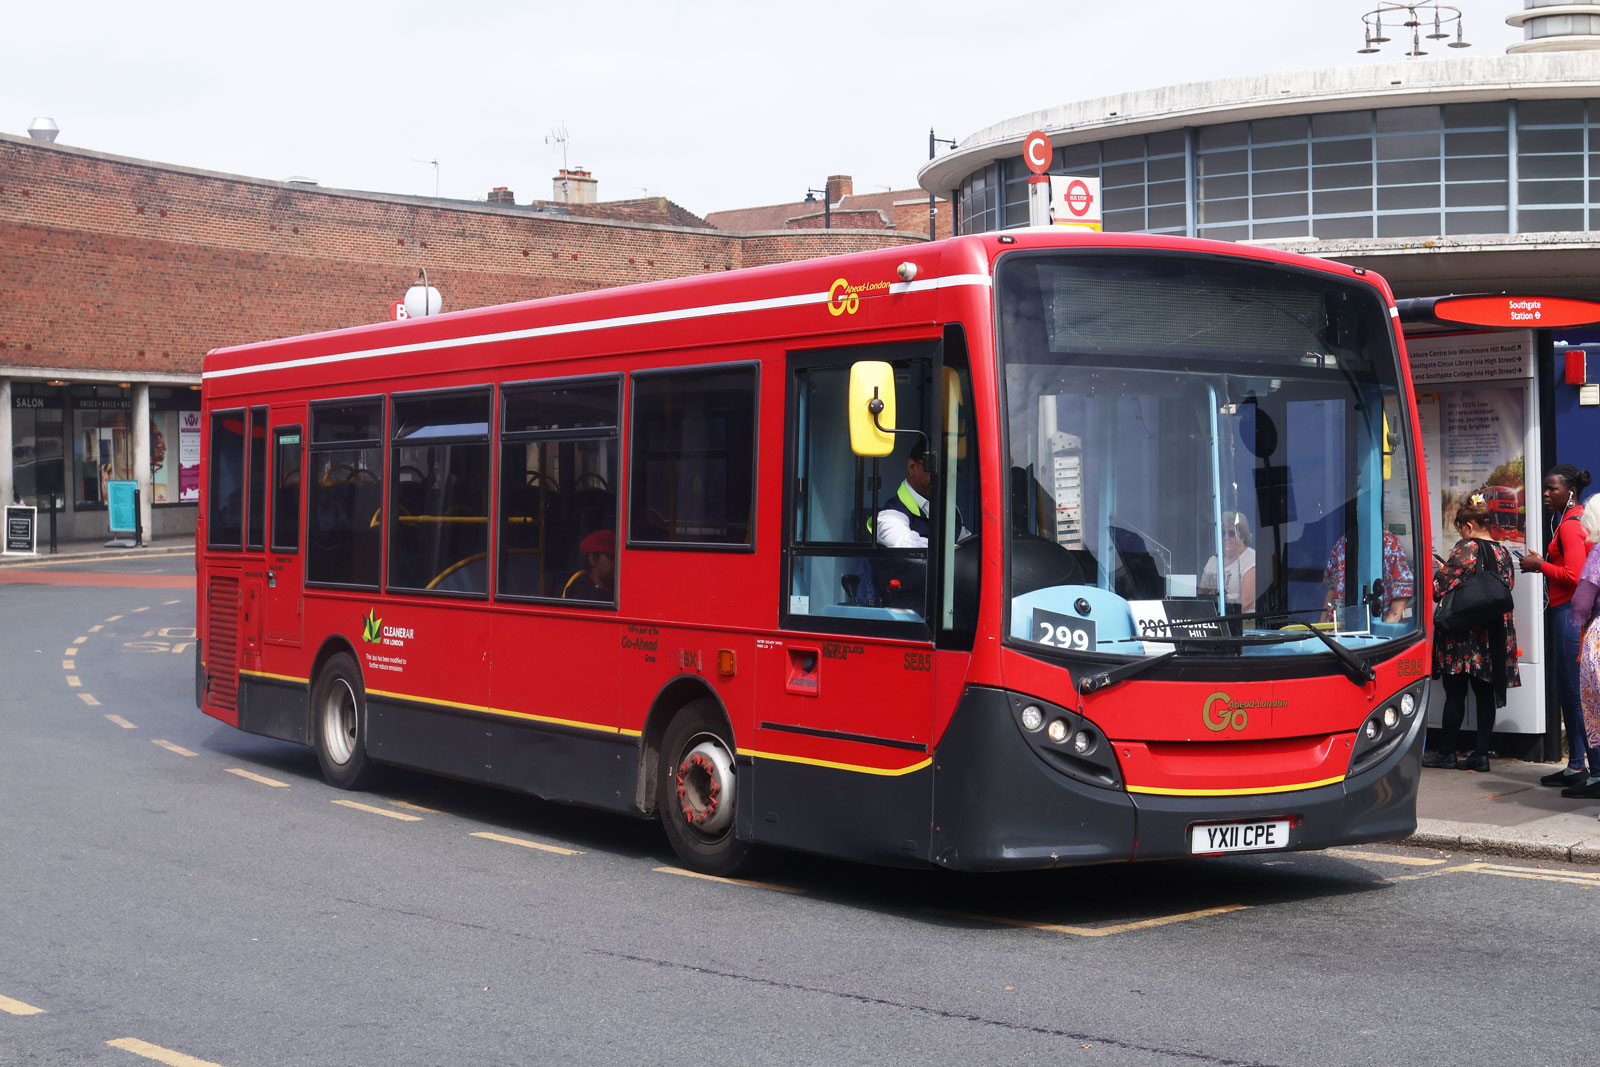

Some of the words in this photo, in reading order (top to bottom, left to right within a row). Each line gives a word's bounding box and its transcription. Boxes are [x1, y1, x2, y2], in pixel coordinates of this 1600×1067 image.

[1028, 138, 1045, 166] C
[828, 278, 859, 316] Go
[845, 280, 891, 294] Ahead-London
[396, 304, 408, 320] B
[1509, 300, 1541, 310] Southgate
[1511, 312, 1533, 320] Station
[1410, 351, 1428, 359] Leisure
[1458, 346, 1489, 355] Winchmore
[1410, 361, 1436, 370] Southgate
[1437, 360, 1454, 368] Circus
[1455, 359, 1473, 367] Library
[1426, 372, 1452, 381] Southgate
[1453, 370, 1473, 379] College
[1484, 368, 1497, 376] High
[16, 398, 44, 408] SALON
[390, 639, 404, 647] LONDON
[621, 636, 659, 651] Go-Ahead
[1039, 622, 1089, 651] 299
[390, 656, 402, 665] modified
[684, 651, 697, 667] BX
[903, 652, 932, 672] SE85
[1397, 659, 1423, 676] SE85
[1202, 691, 1248, 732] Go
[1228, 698, 1289, 709] Ahead-London
[1207, 826, 1239, 849] YX11
[1243, 824, 1276, 847] CPE
